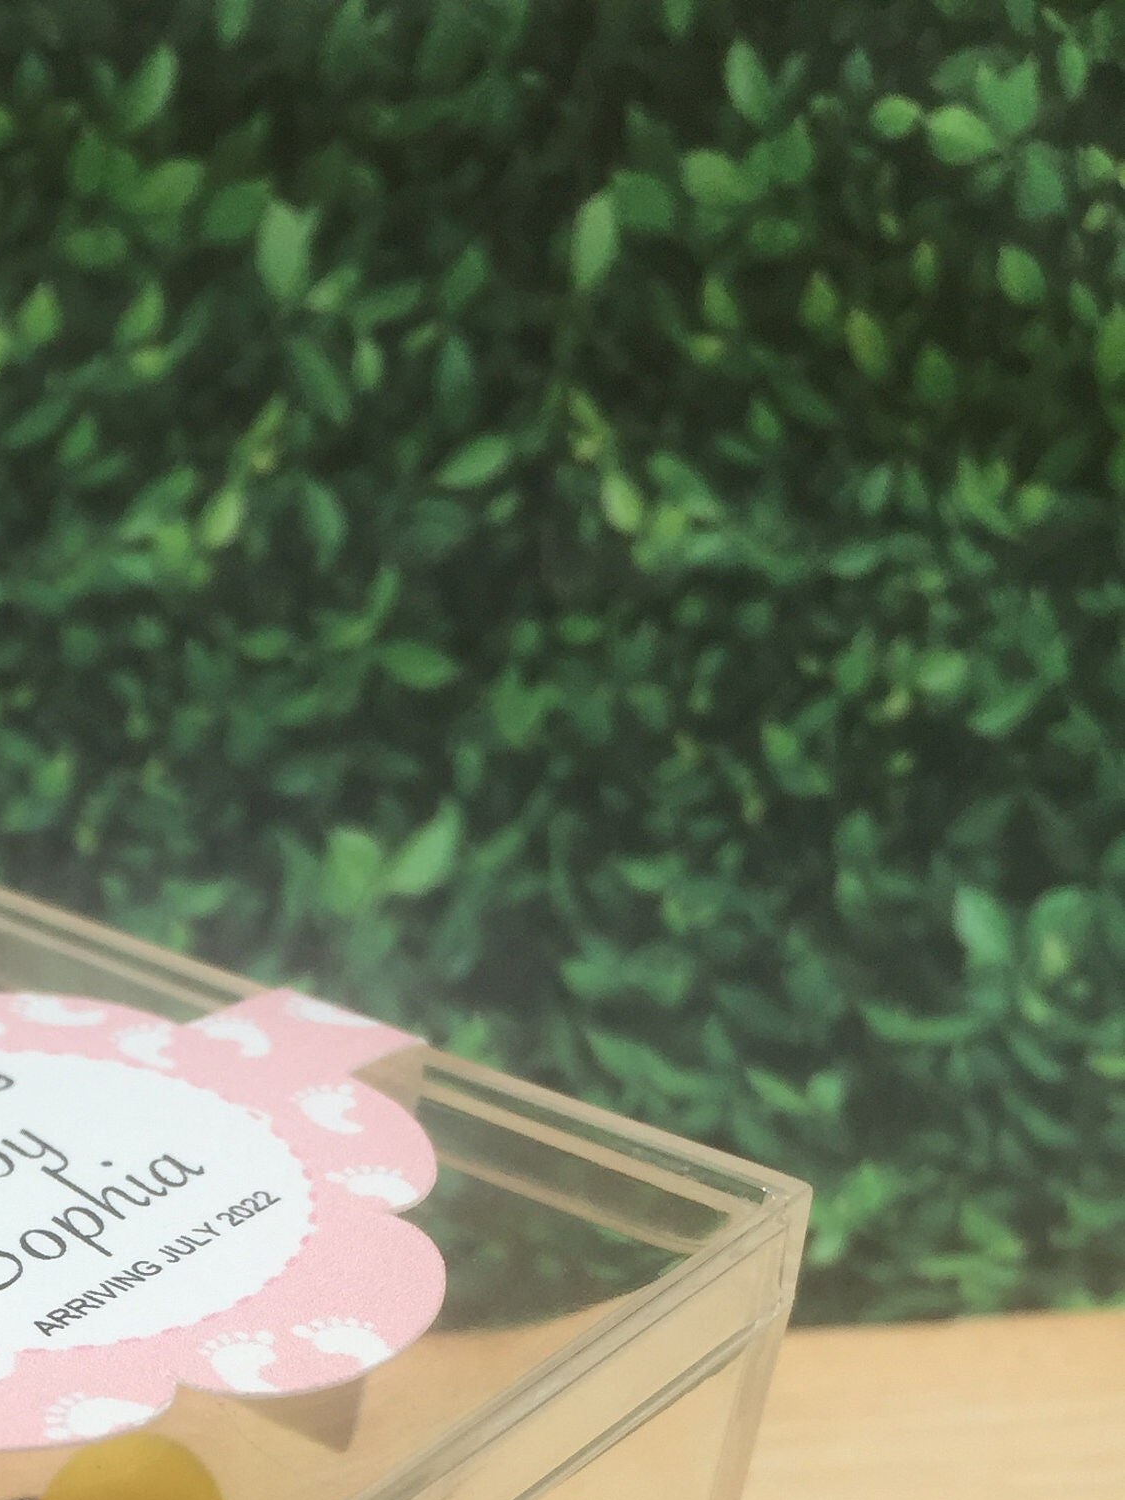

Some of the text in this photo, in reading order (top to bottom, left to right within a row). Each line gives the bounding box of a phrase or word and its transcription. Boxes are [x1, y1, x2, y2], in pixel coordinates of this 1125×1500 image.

[33, 1189, 282, 1337] ARRIVING JULY 2022
